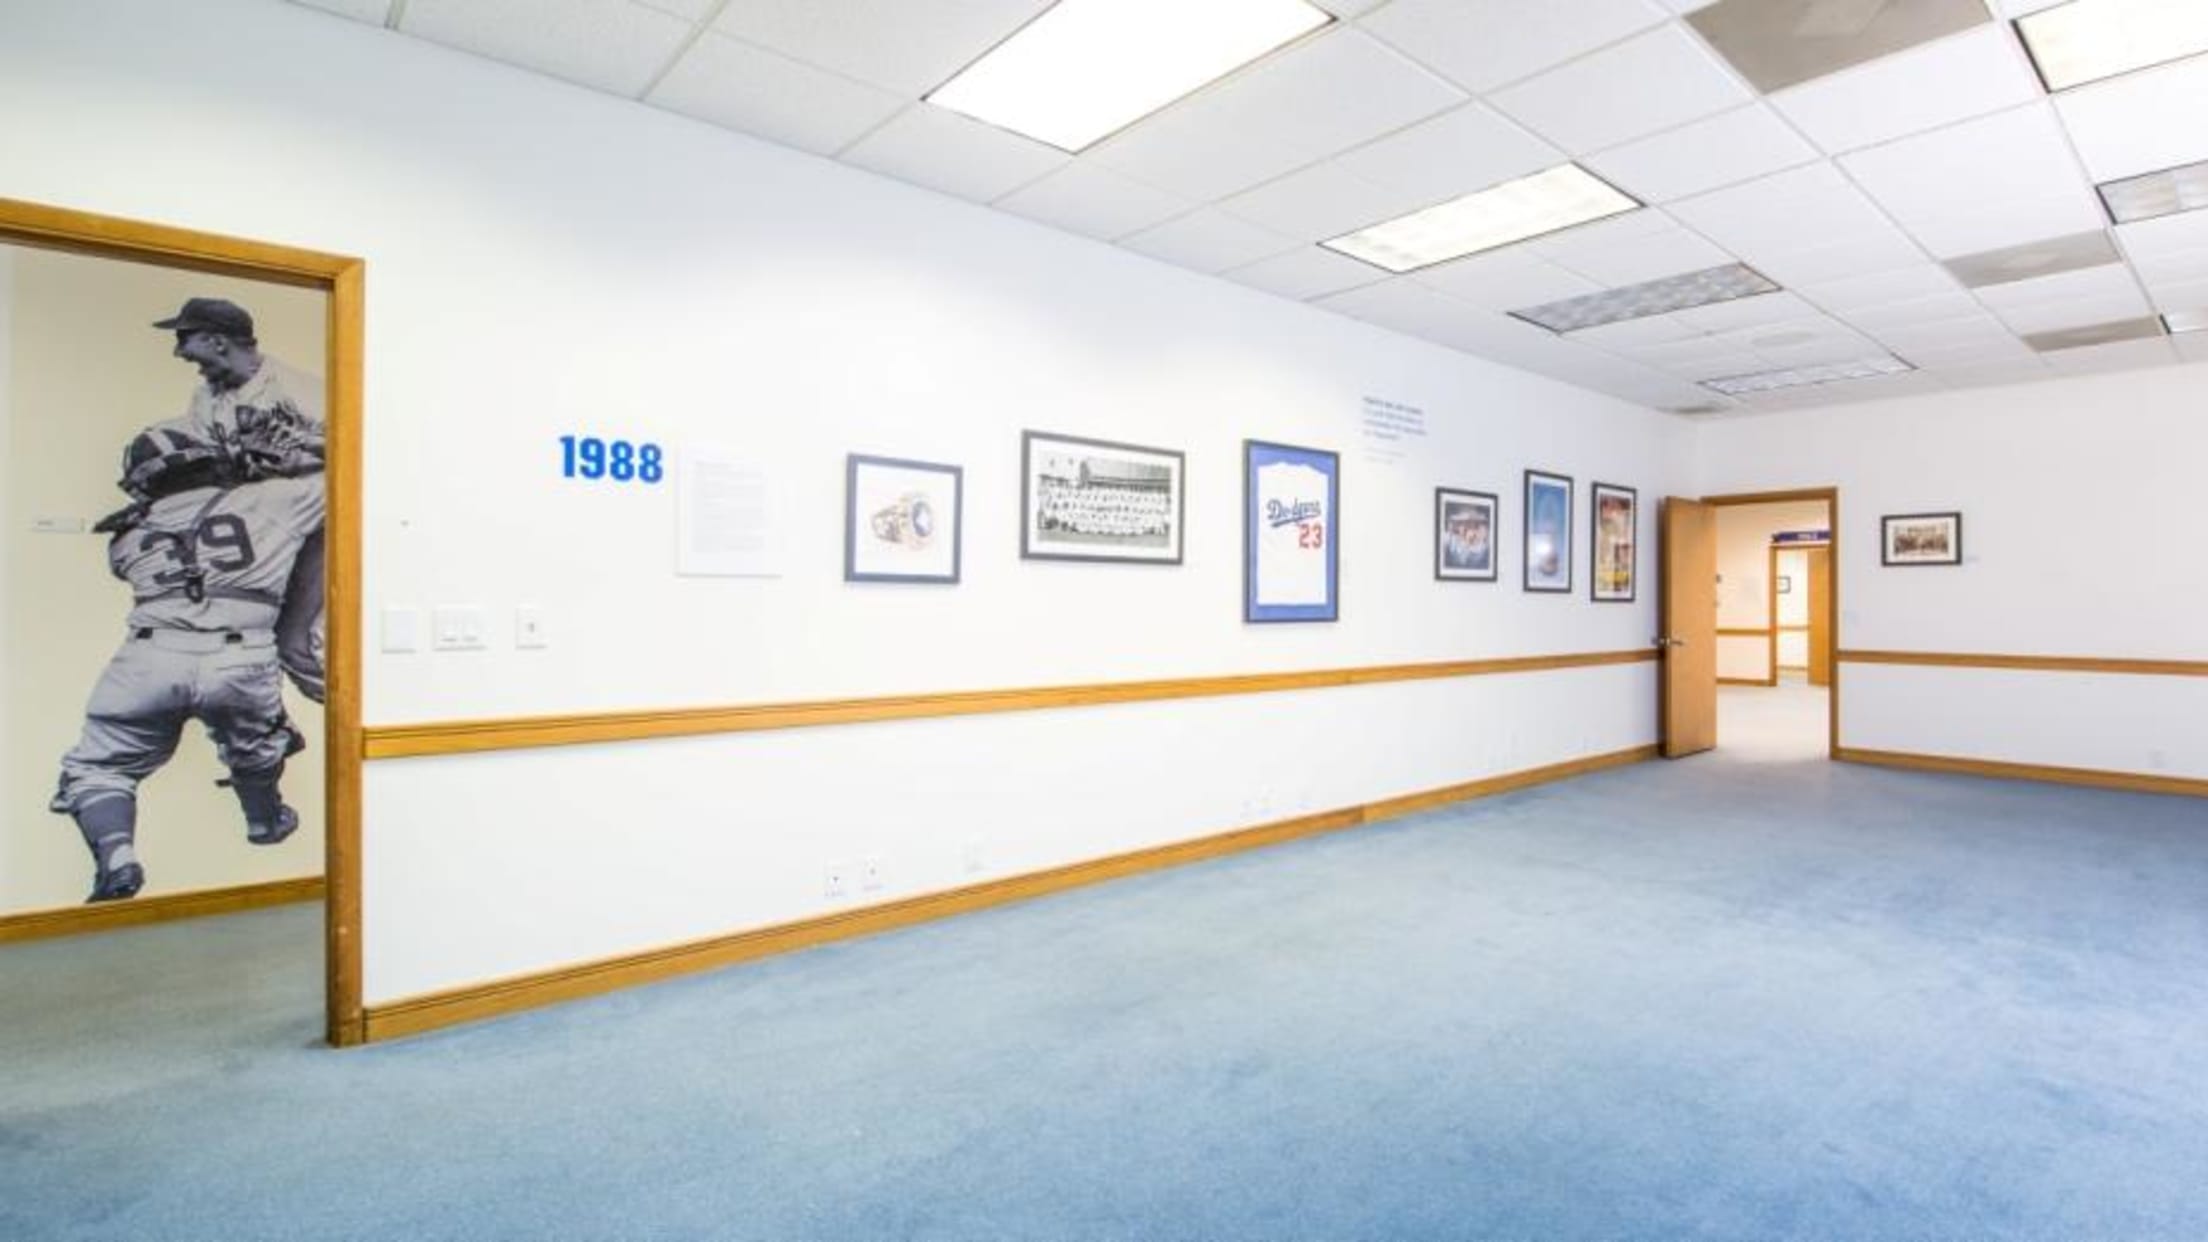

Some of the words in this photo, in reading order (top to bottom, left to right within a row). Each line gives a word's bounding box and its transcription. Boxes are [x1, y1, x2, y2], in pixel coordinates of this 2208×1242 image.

[559, 435, 663, 484] 1988
[140, 514, 255, 585] 39
[1299, 522, 1323, 549] 23
